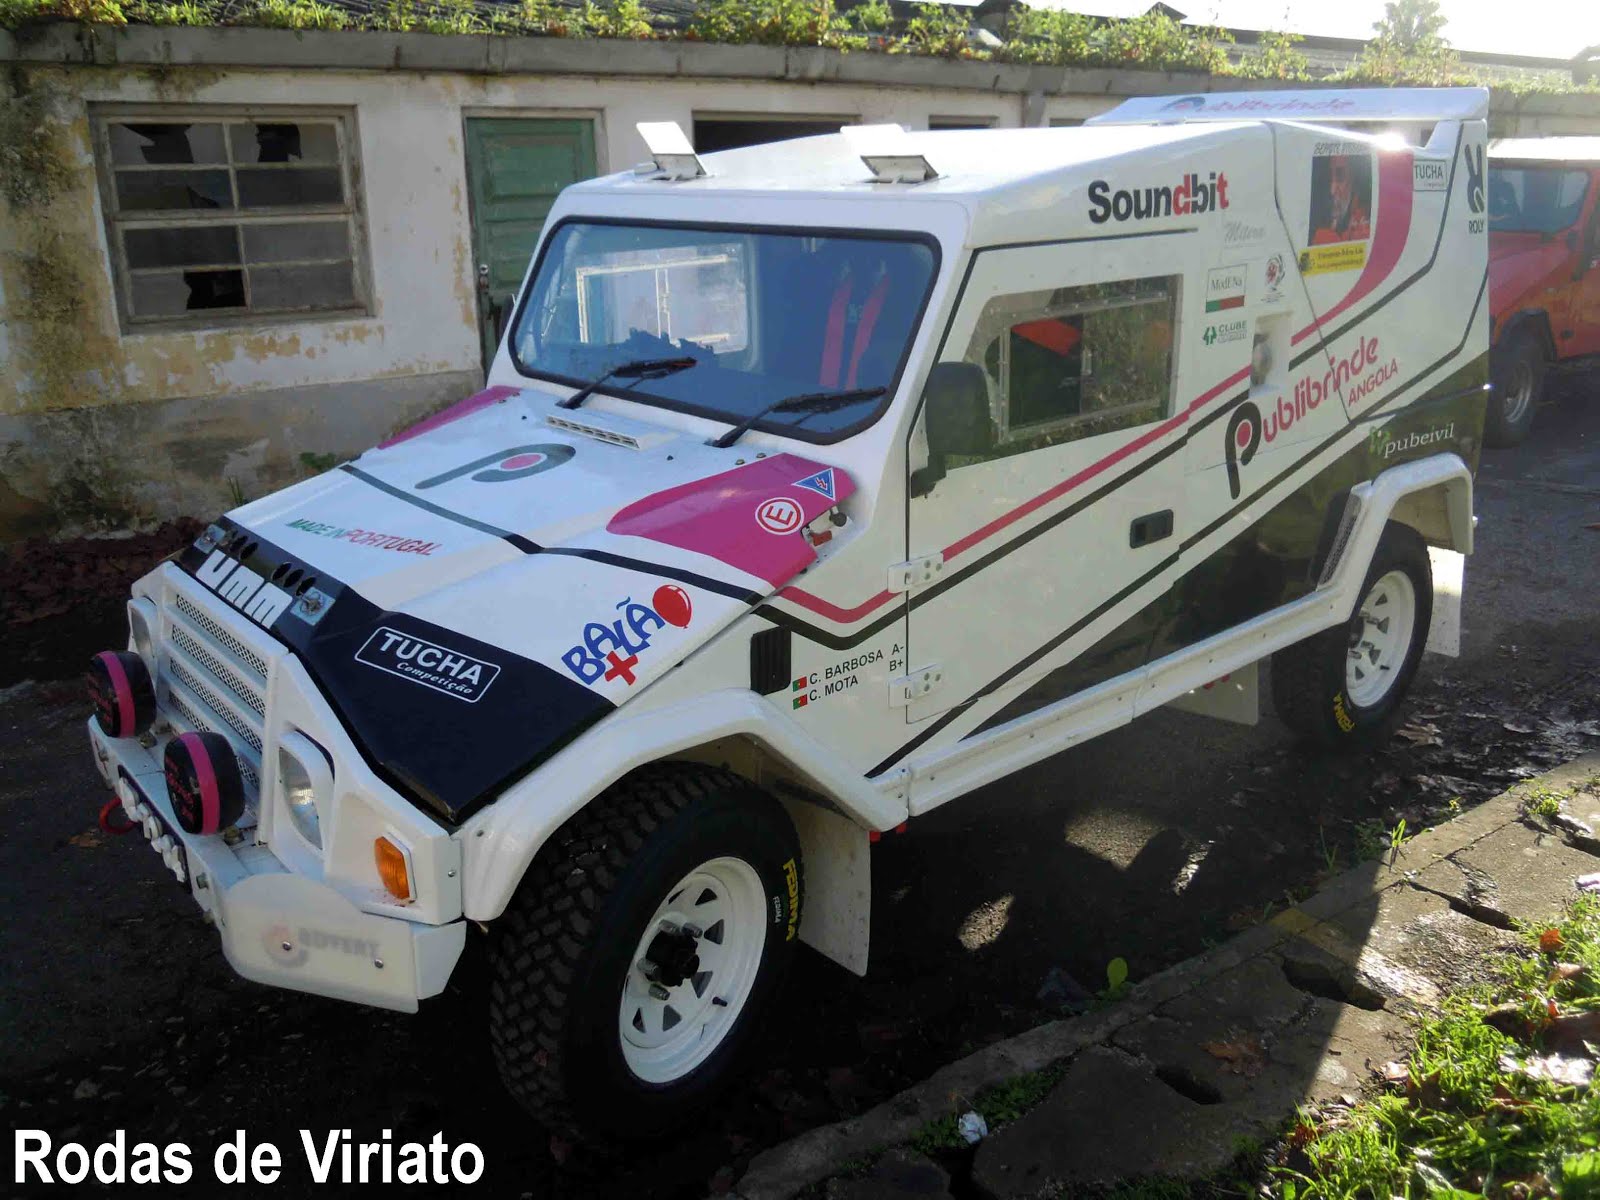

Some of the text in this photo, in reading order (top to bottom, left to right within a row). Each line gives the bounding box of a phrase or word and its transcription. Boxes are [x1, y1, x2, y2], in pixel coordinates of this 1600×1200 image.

[1414, 164, 1443, 180] TUCHA
[1087, 171, 1230, 225] Soundbit
[1468, 220, 1485, 234] ROLY
[1219, 320, 1248, 333] CLUBE
[1348, 358, 1399, 407] ANGOLA
[1225, 336, 1379, 500] Publibrinde
[1383, 422, 1455, 458] pubeivil
[765, 504, 794, 526] E
[379, 632, 483, 686] TUCHA
[396, 662, 473, 694] Competição
[809, 643, 905, 685] C. BARBOSA A-
[809, 659, 904, 701] C. MOTA B+
[783, 858, 799, 942] FEDIMA
